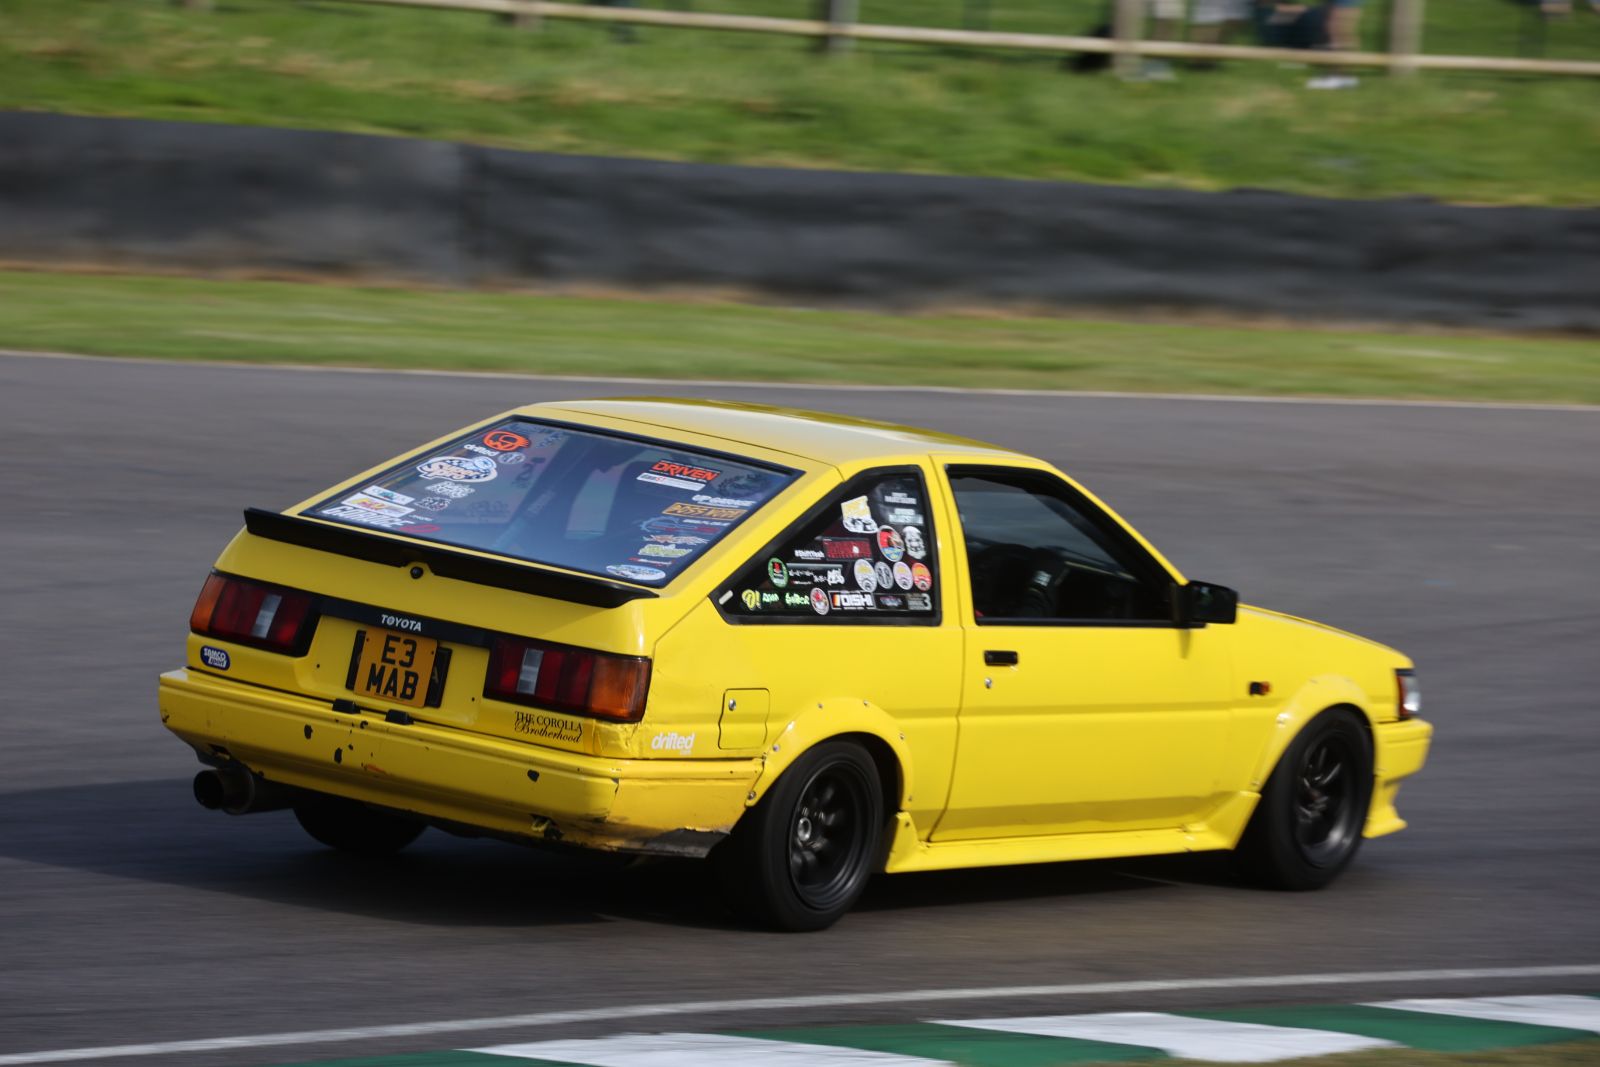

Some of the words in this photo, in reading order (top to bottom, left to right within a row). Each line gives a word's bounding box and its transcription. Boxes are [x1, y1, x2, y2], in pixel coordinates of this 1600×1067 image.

[651, 460, 721, 481] DRIVEN
[381, 614, 422, 632] TOYOTA
[381, 634, 417, 668] E3
[366, 663, 419, 700] MAB
[514, 720, 583, 743] Brotherhood
[515, 711, 536, 724] THE
[536, 715, 583, 732] COROLLA
[651, 732, 695, 750] drifted
